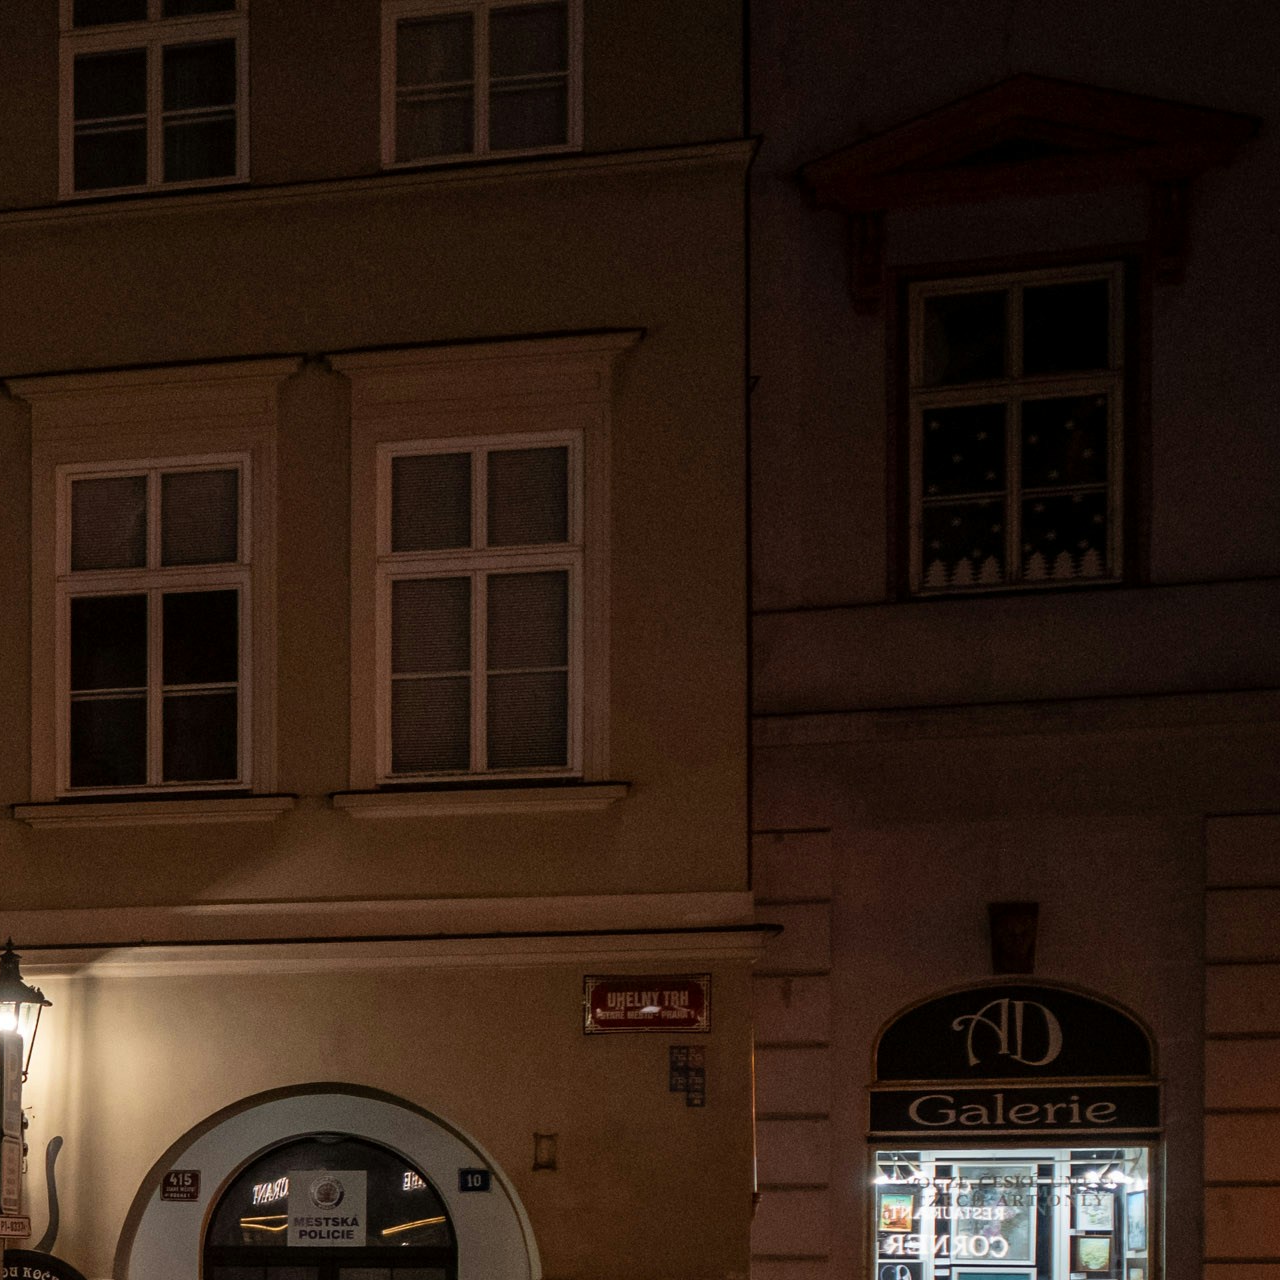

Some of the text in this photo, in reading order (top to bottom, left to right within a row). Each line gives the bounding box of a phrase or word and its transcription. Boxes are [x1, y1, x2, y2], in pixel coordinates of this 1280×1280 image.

[662, 990, 689, 1007] TRH
[952, 998, 1063, 1067] AD
[908, 1093, 1117, 1126] Galerie
[169, 1173, 192, 1186] 415
[465, 1174, 482, 1187] 10
[995, 1194, 1038, 1207] ART
[1046, 1194, 1106, 1207] ONLY
[298, 1229, 355, 1240] POLICIE
